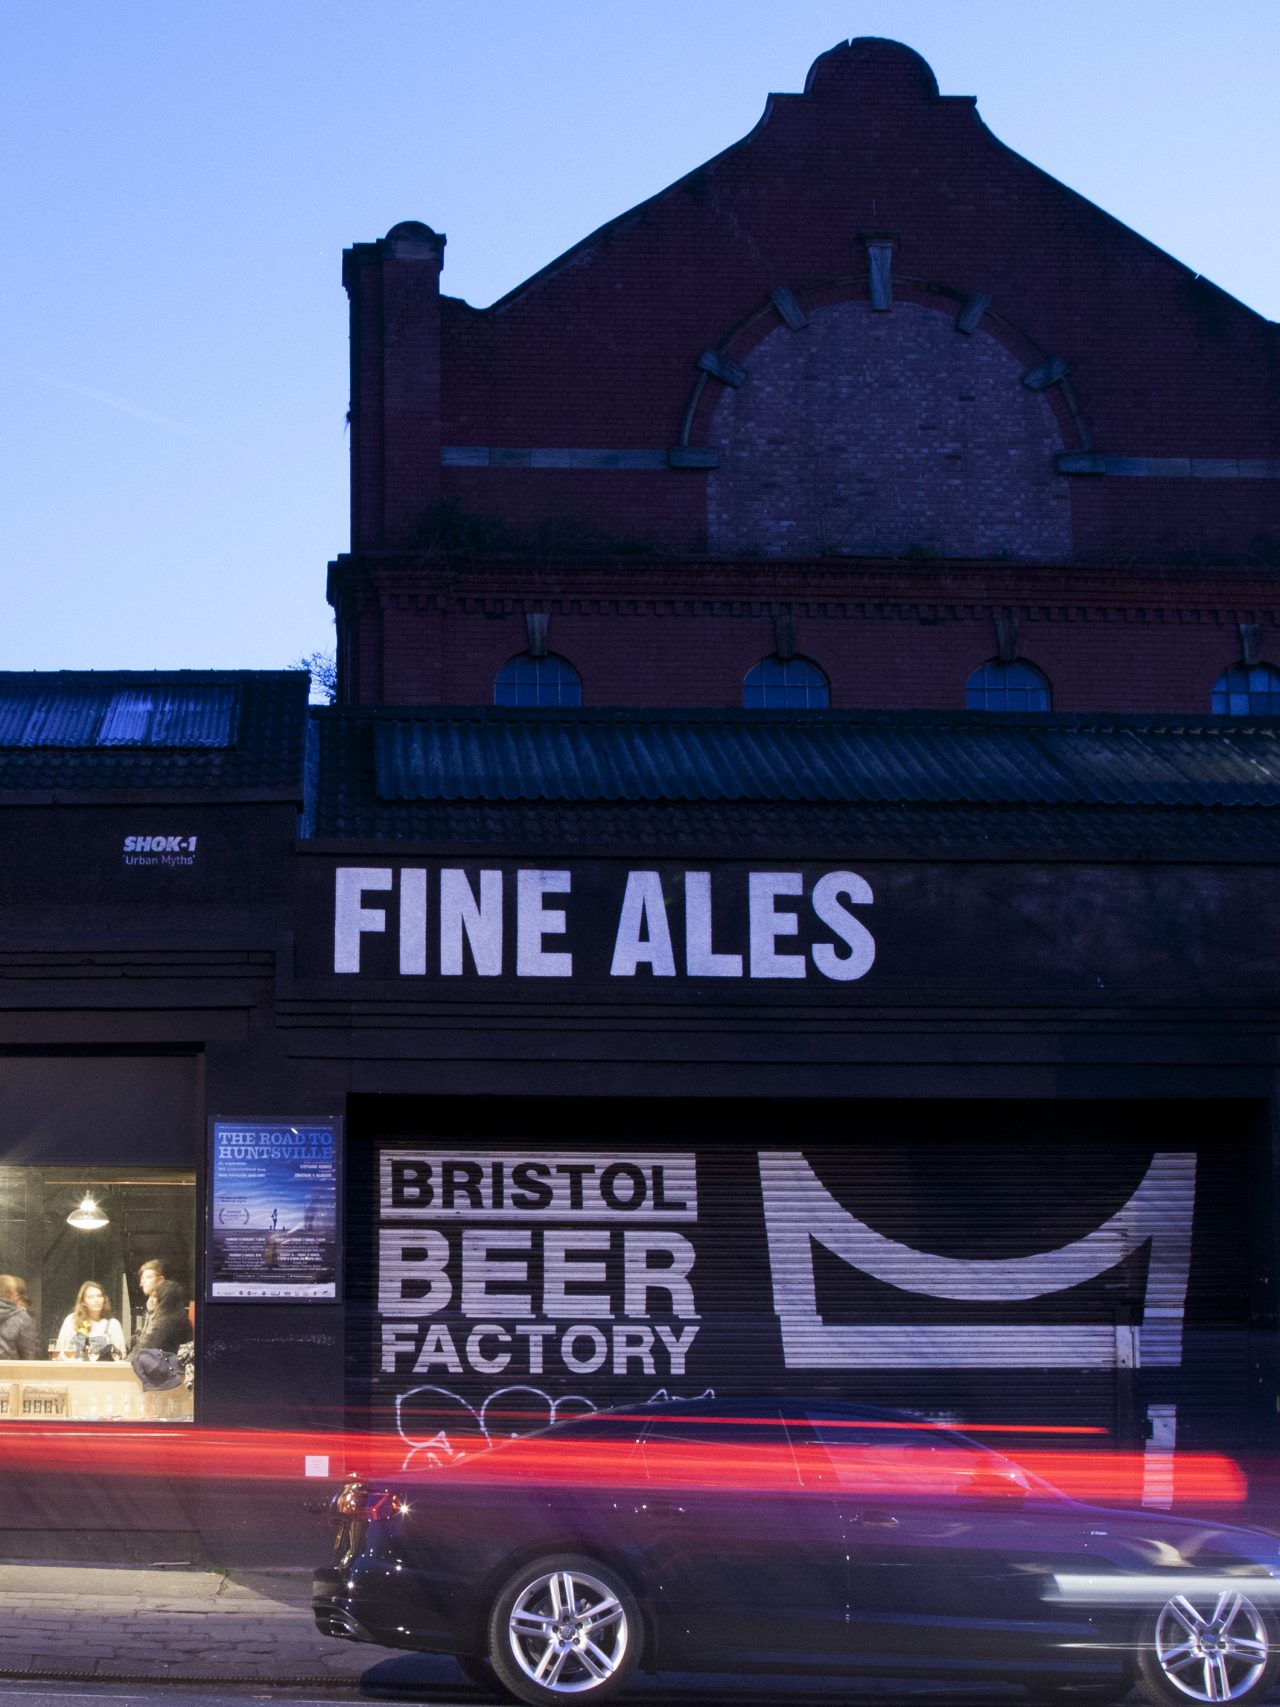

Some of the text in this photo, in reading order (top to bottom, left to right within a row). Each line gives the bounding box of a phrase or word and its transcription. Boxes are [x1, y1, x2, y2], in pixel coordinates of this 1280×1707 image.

[123, 836, 197, 852] SHOK-1
[334, 867, 876, 981] FINE ALES
[219, 1132, 333, 1146] THE ROAD TO
[219, 1146, 333, 1159] HUNTSVILLE
[391, 1160, 687, 1211] BRISTOL
[378, 1229, 702, 1319] BEER
[381, 1324, 700, 1374] FACTORY
